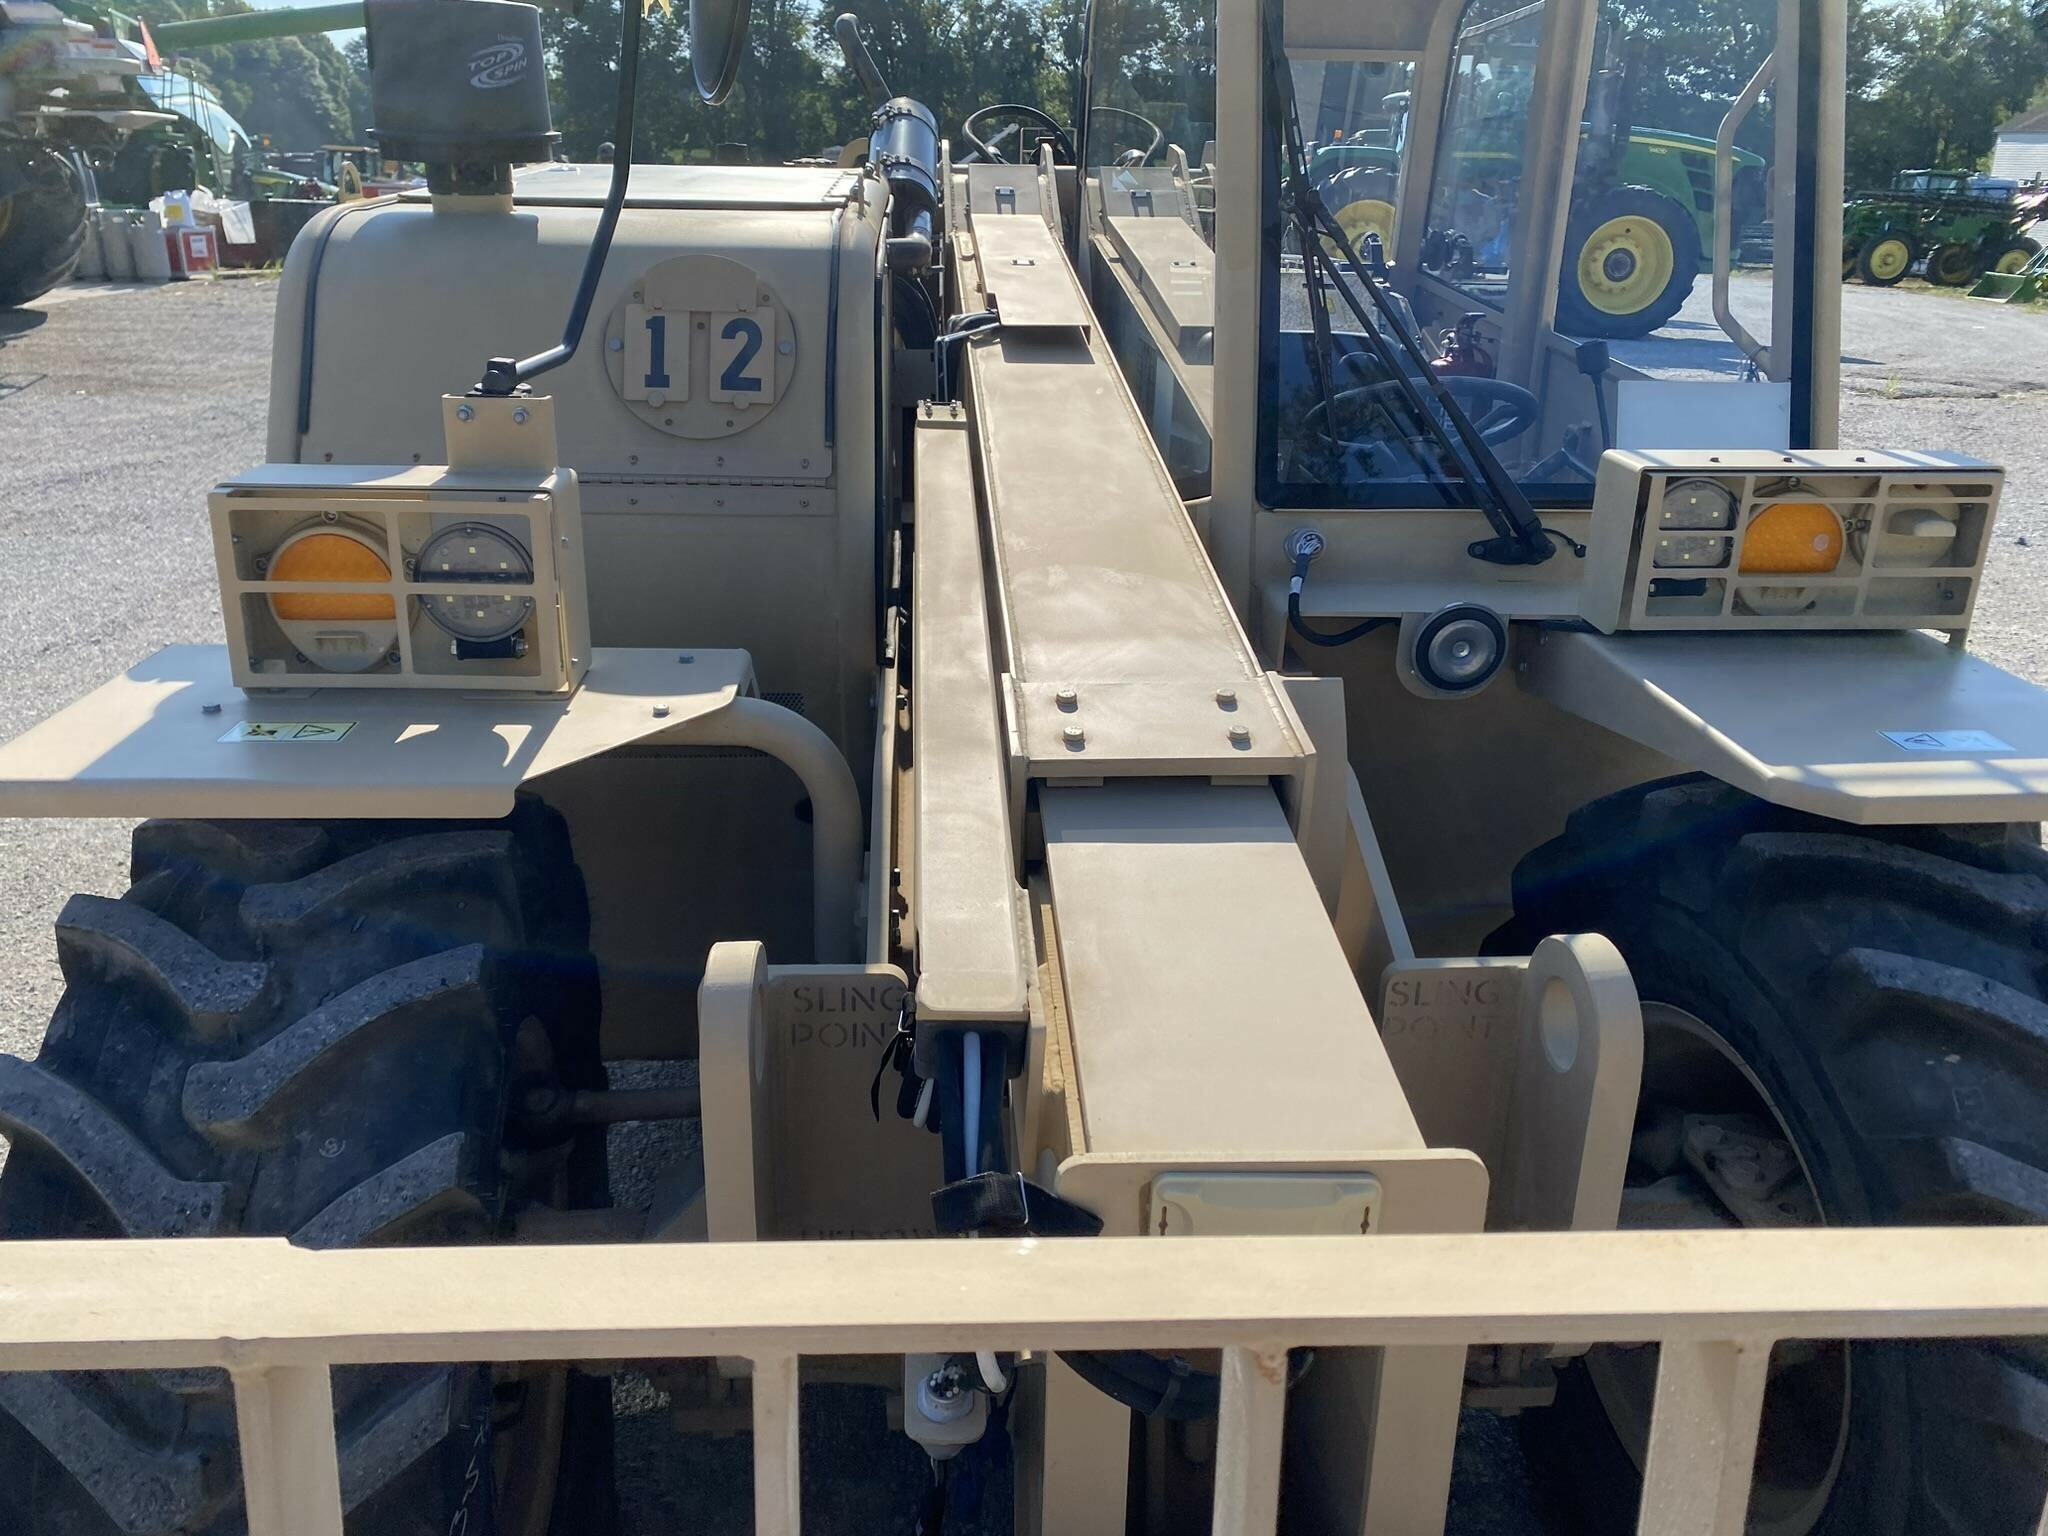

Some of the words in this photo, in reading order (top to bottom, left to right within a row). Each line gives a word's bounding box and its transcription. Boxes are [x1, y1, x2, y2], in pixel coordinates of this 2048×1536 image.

[468, 52, 507, 71] TOP
[493, 57, 527, 79] SPIN
[1385, 1014, 1506, 1040] PONT
